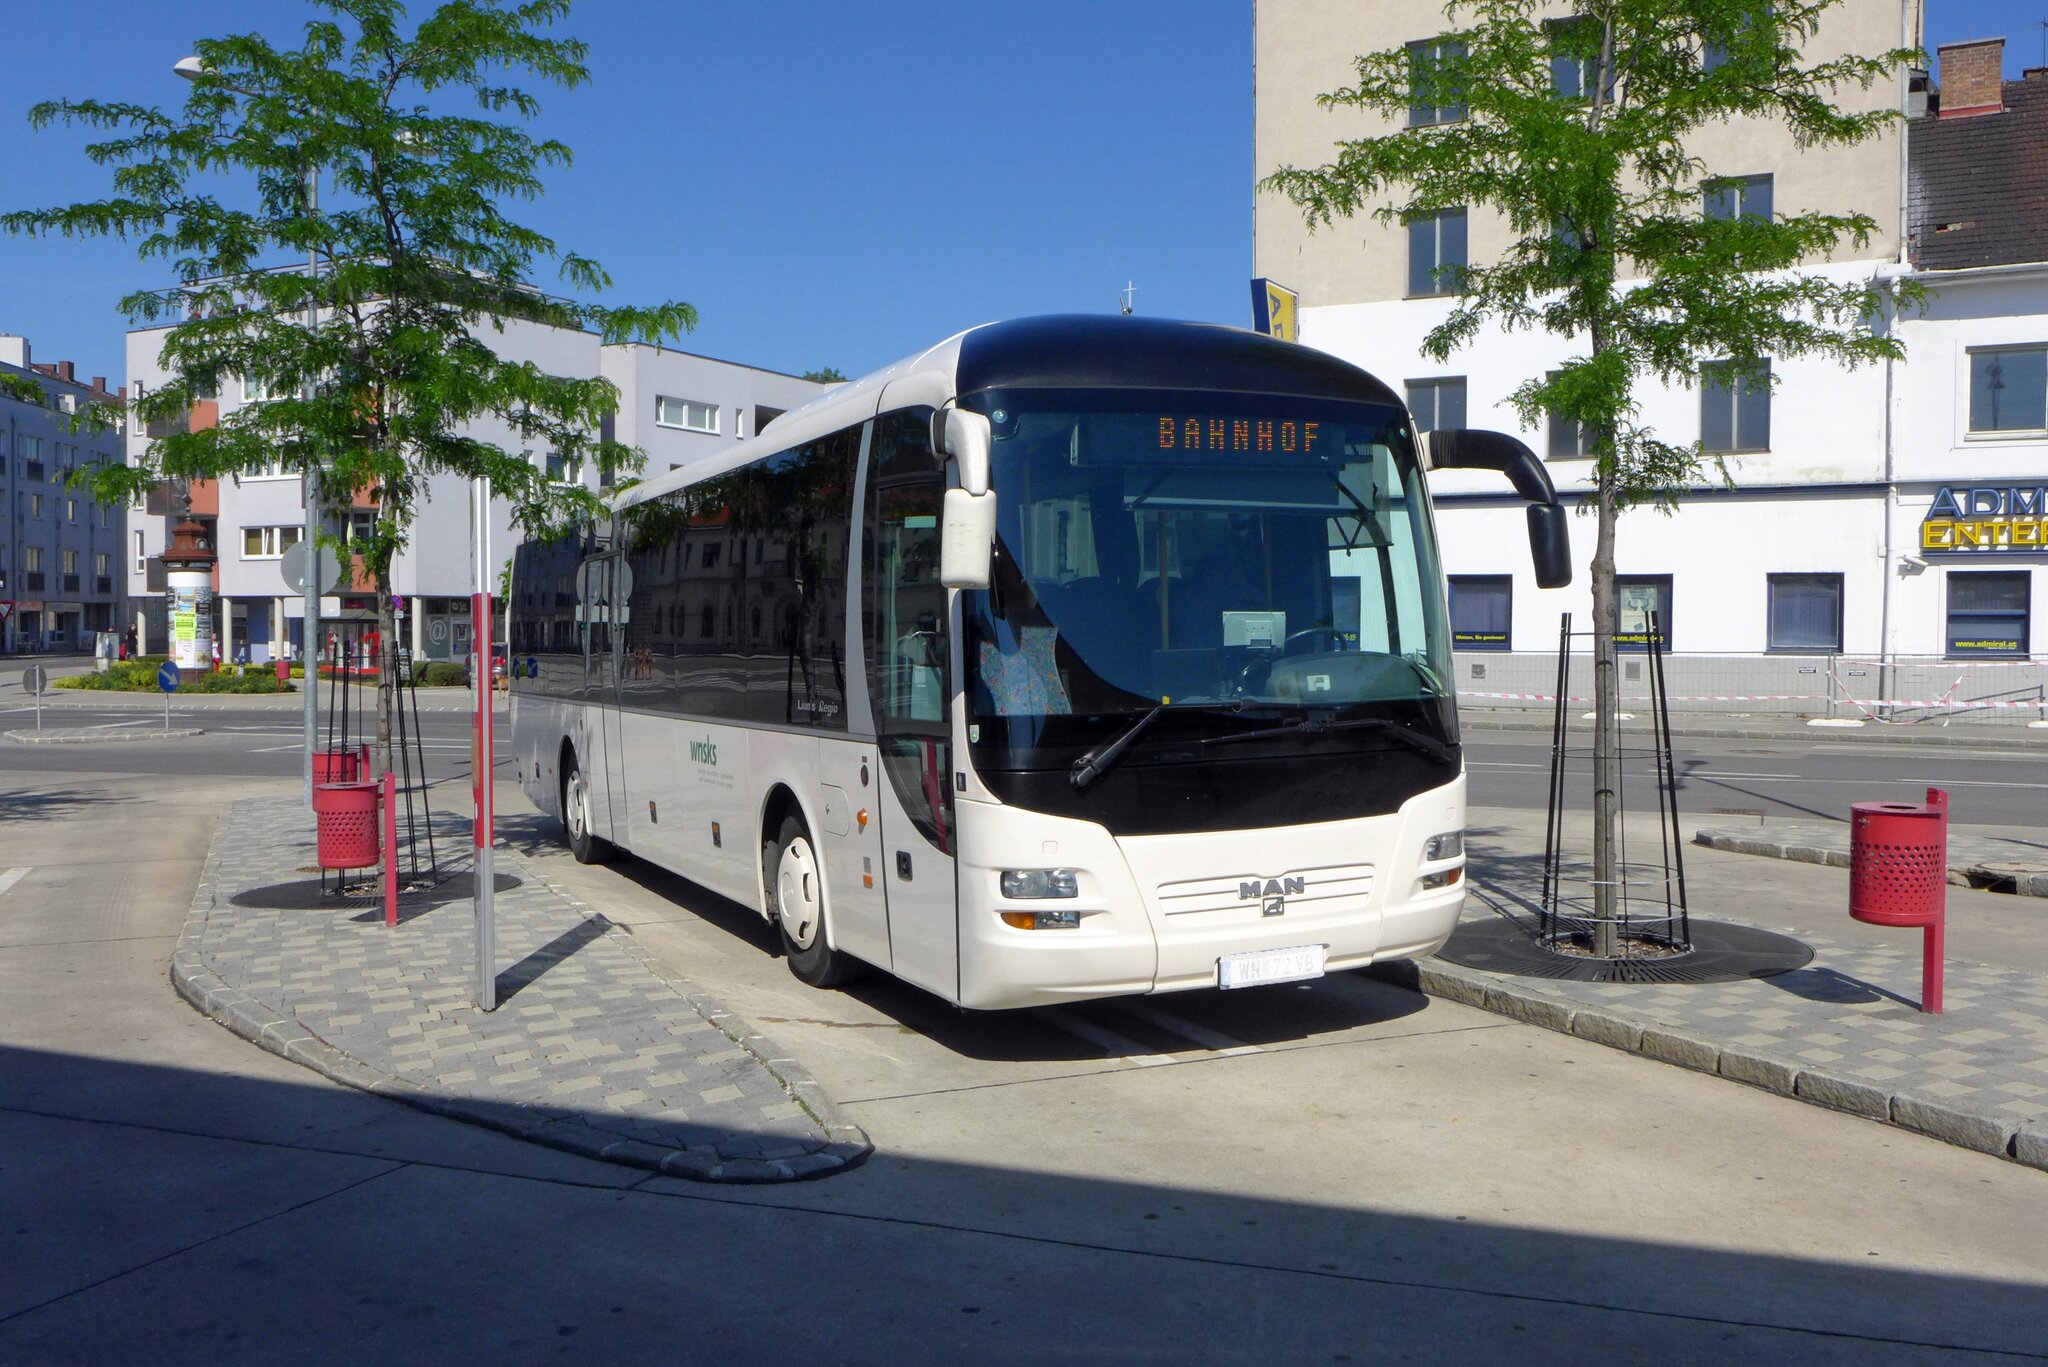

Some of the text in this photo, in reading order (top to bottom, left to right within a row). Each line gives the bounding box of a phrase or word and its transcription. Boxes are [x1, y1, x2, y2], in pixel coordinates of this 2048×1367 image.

[1159, 417, 1319, 451] BAHNHOF
[797, 699, 839, 717] Lion's Regio
[690, 734, 717, 766] wnsks
[1239, 876, 1305, 900] MAN
